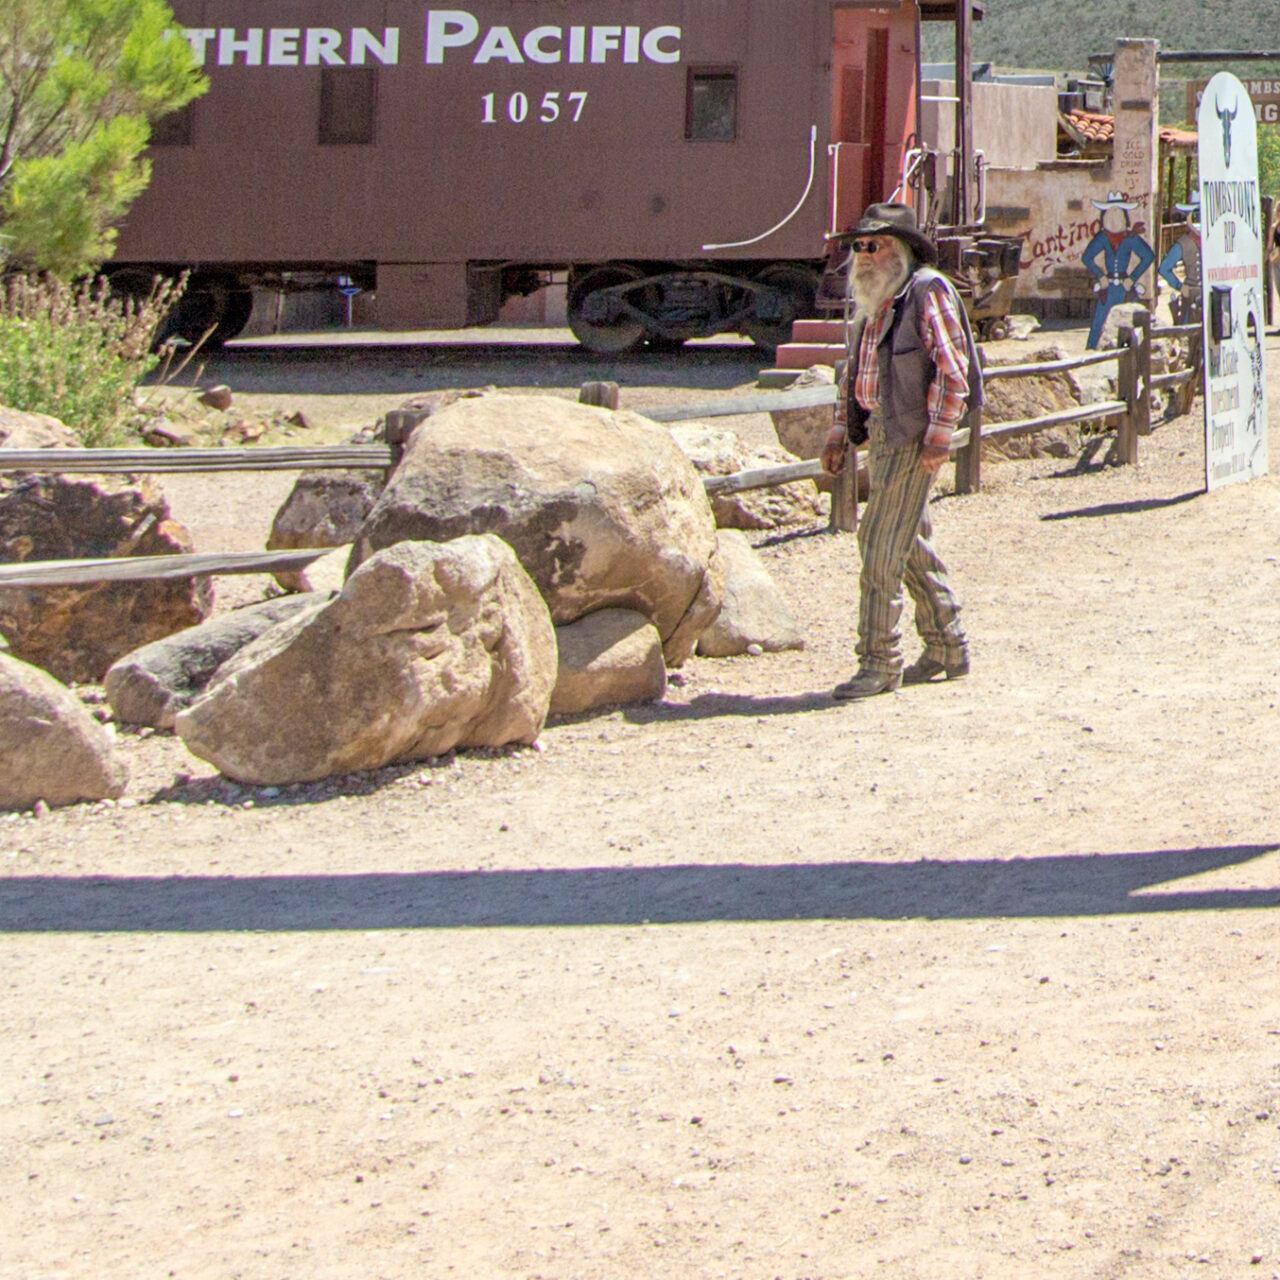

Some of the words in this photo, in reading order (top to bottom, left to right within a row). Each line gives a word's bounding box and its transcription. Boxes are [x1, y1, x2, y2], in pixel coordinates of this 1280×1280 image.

[163, 26, 400, 66] THERN
[425, 9, 682, 65] PACIFIC
[480, 91, 588, 124] 1057
[1202, 180, 1258, 240] TOMBSTONE
[1224, 221, 1236, 253] RIP
